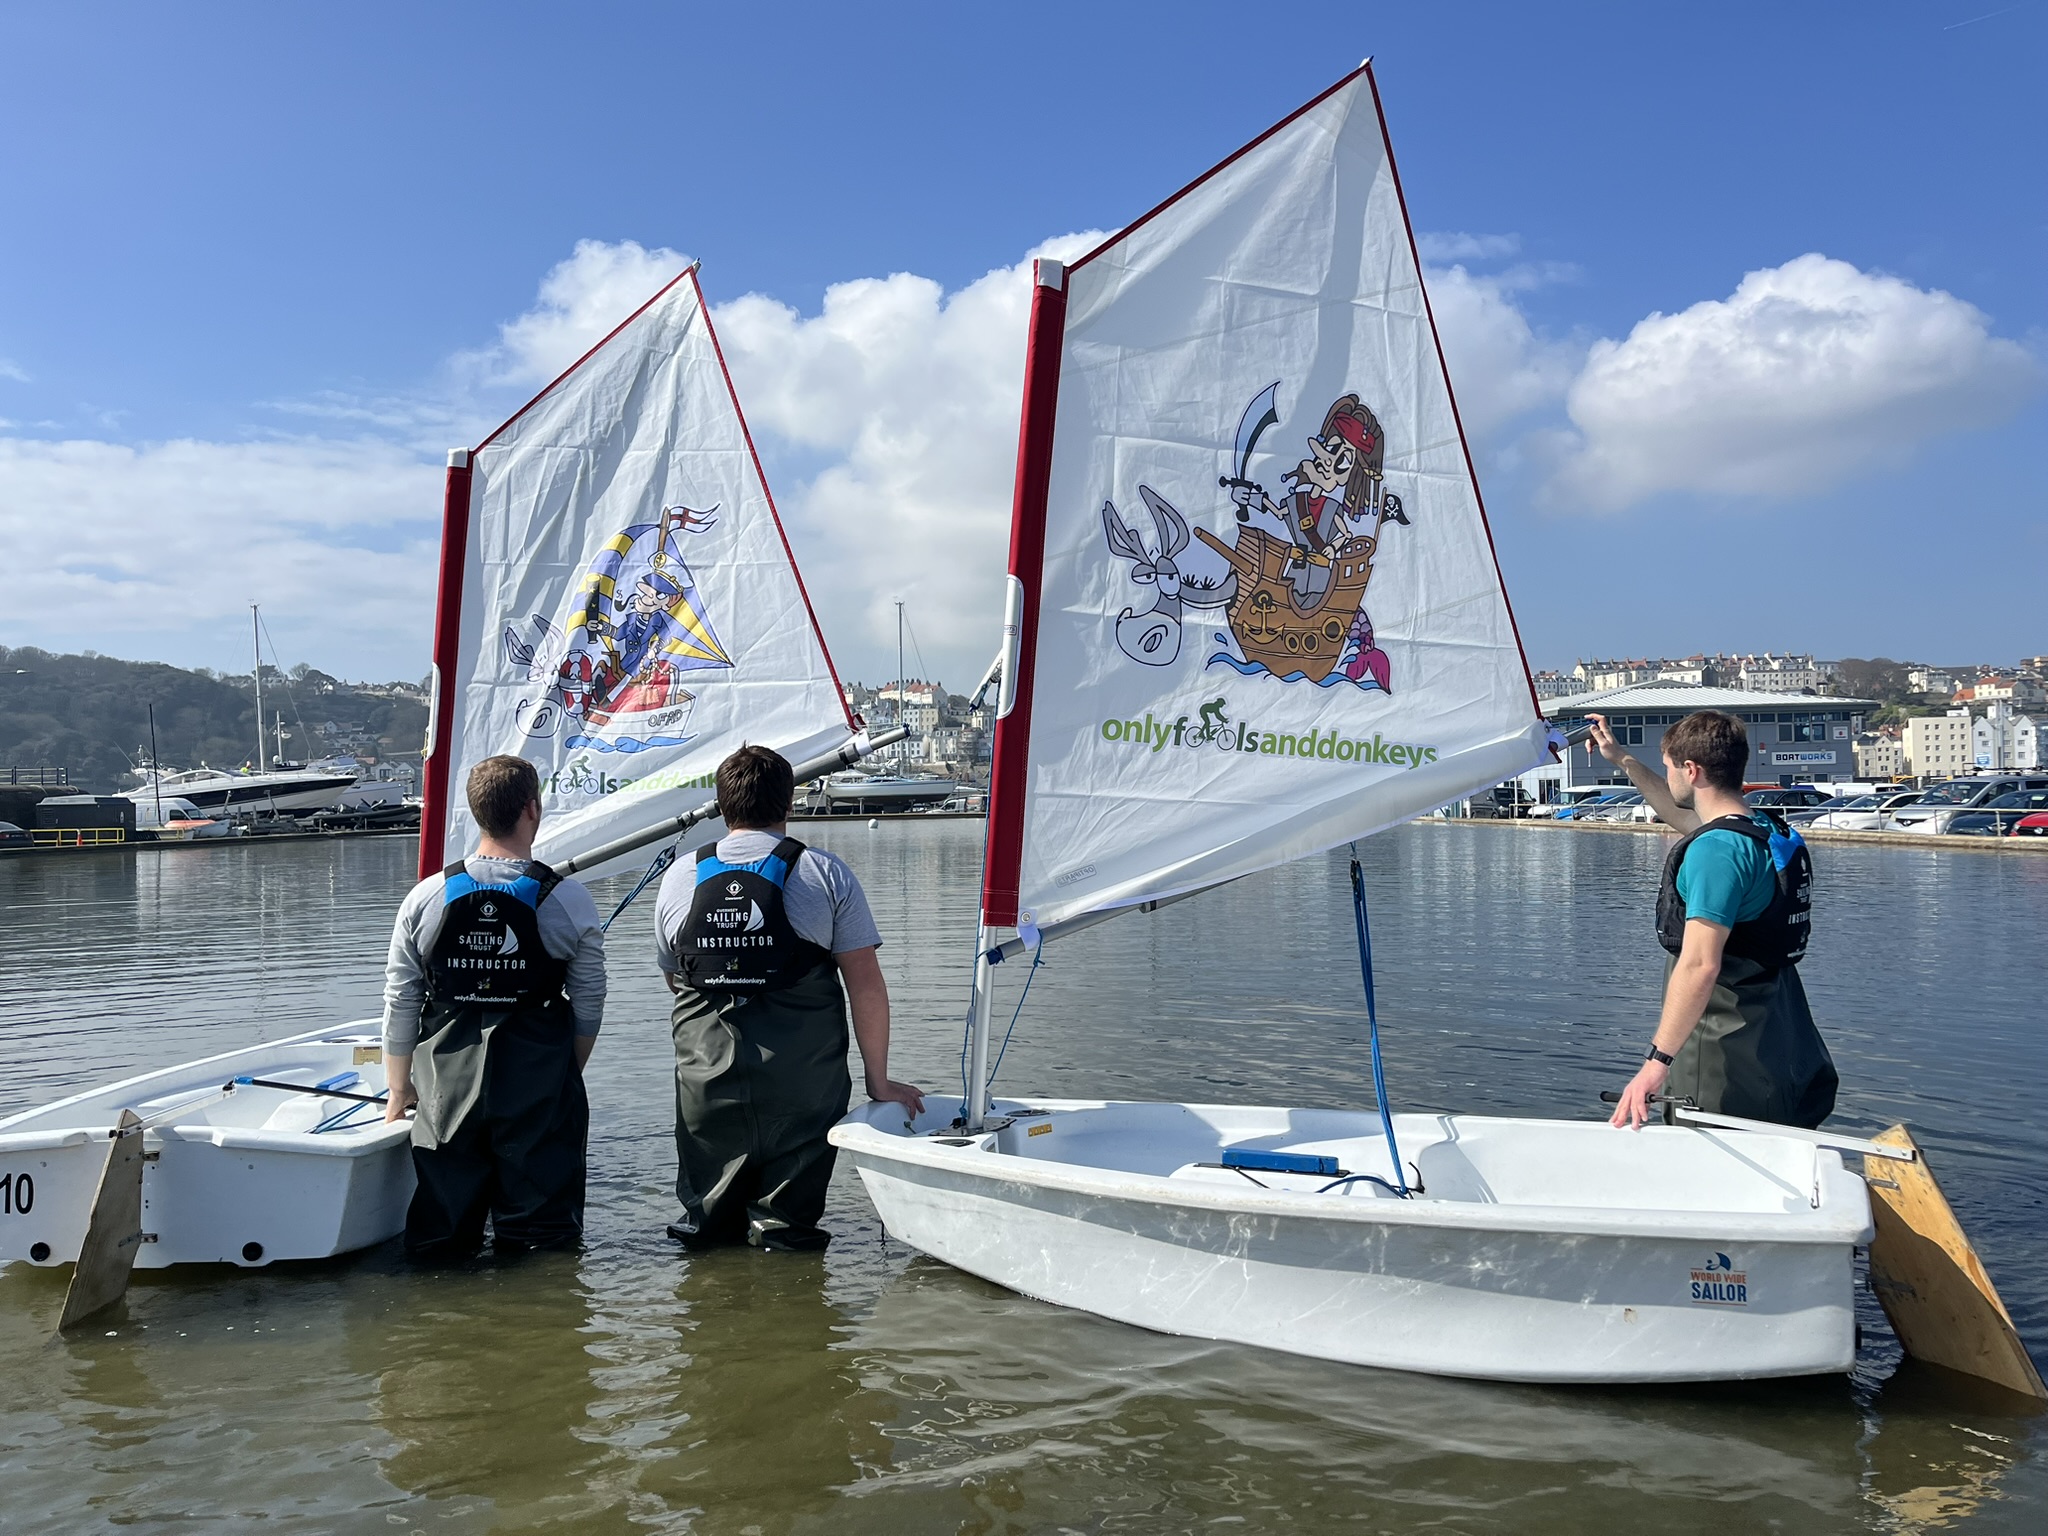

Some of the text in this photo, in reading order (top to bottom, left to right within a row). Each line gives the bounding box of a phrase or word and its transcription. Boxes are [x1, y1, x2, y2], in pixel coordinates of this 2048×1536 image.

[648, 709, 684, 727] OFAD
[1775, 752, 1833, 761] BOATWORKS
[706, 912, 749, 922] SAILING
[458, 935, 503, 945] SAILING
[696, 935, 773, 948] INSTRUCTOR
[447, 957, 526, 969] INSTRUCTOR
[0, 1172, 34, 1215] 10
[1690, 1271, 1747, 1284] WORLD WIDE
[1691, 1282, 1747, 1302] SAILOR
